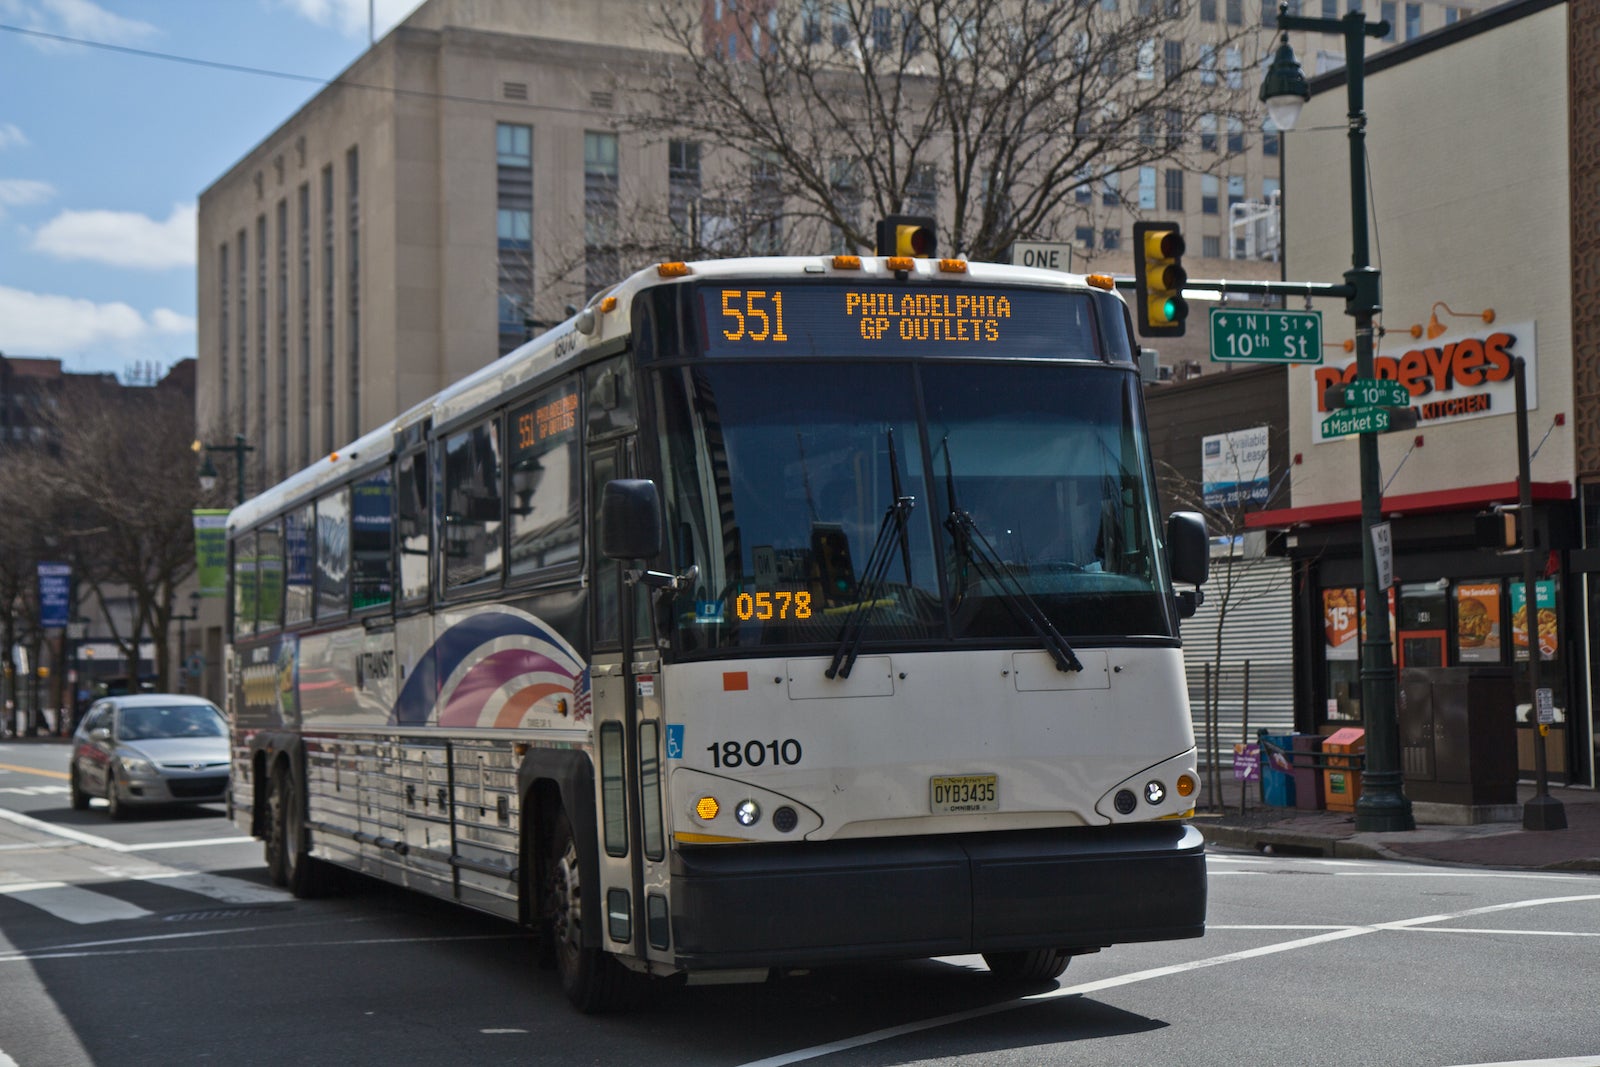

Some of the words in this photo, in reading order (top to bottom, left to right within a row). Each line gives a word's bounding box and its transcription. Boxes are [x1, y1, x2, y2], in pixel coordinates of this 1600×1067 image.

[1024, 249, 1060, 268] ONE
[721, 290, 789, 342] 551
[846, 292, 1011, 318] PHILADELPHIA
[860, 318, 890, 340] GP
[899, 318, 999, 342] OUTLETS
[1227, 333, 1270, 356] 10th
[1284, 335, 1308, 358] St
[1362, 388, 1387, 404] 10th
[1392, 389, 1407, 404] St
[1423, 393, 1491, 420] KITCHEN
[519, 412, 535, 449] 551
[1331, 415, 1371, 435] Market
[1375, 413, 1388, 428] St
[1228, 431, 1267, 449] Available
[1241, 449, 1267, 463] Lease
[736, 591, 812, 620] 0578
[706, 738, 802, 768] 18010
[950, 804, 981, 812] OMNIBUS
